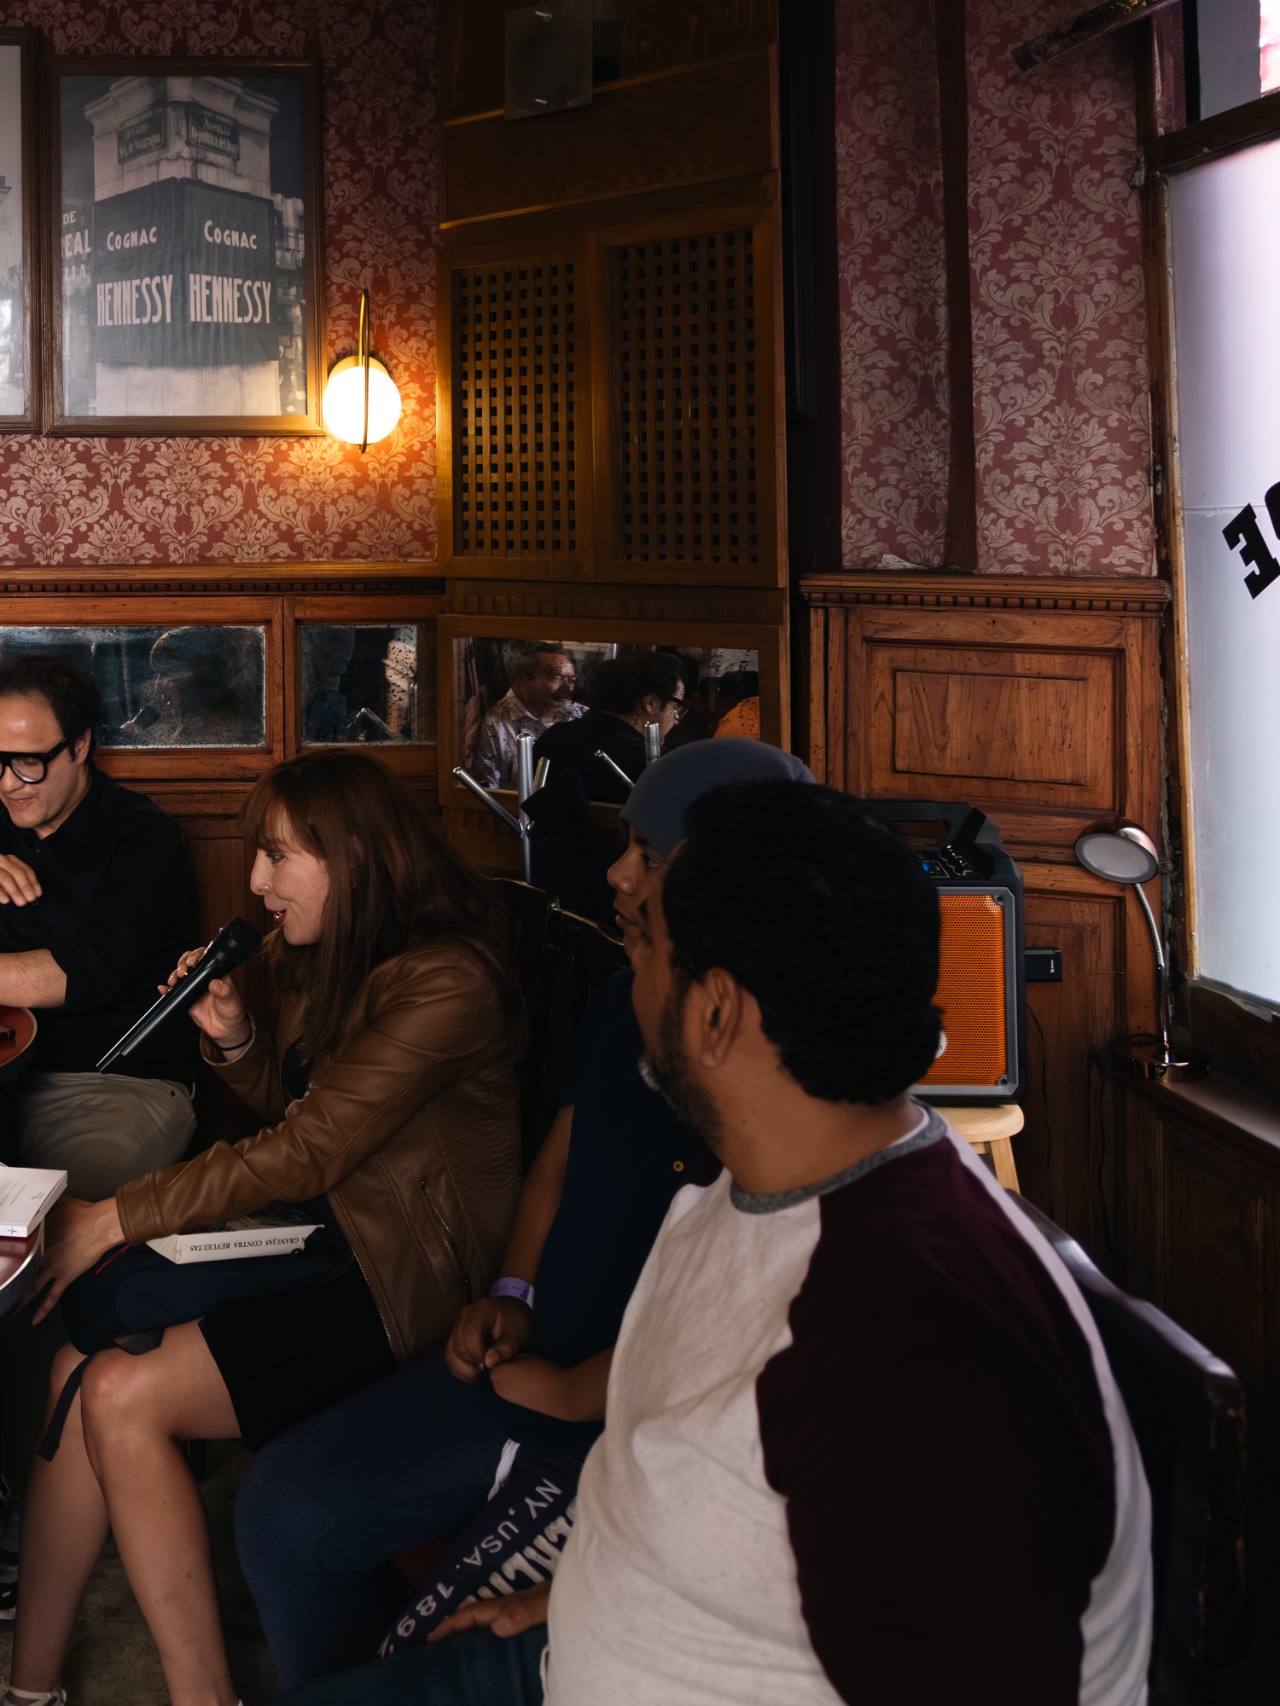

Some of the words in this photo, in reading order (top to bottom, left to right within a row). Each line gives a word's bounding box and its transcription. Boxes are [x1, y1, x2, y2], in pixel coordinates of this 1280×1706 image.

[61, 229, 91, 258] EAL
[106, 226, 158, 251] COGNAC
[204, 219, 258, 250] COGNAC
[97, 274, 174, 327] HENNESSY
[189, 272, 272, 325] HENNESSY
[190, 1242, 231, 1253] REVUELTAS
[233, 1240, 263, 1249] CONTRA
[265, 1237, 300, 1247] GRANUJAS
